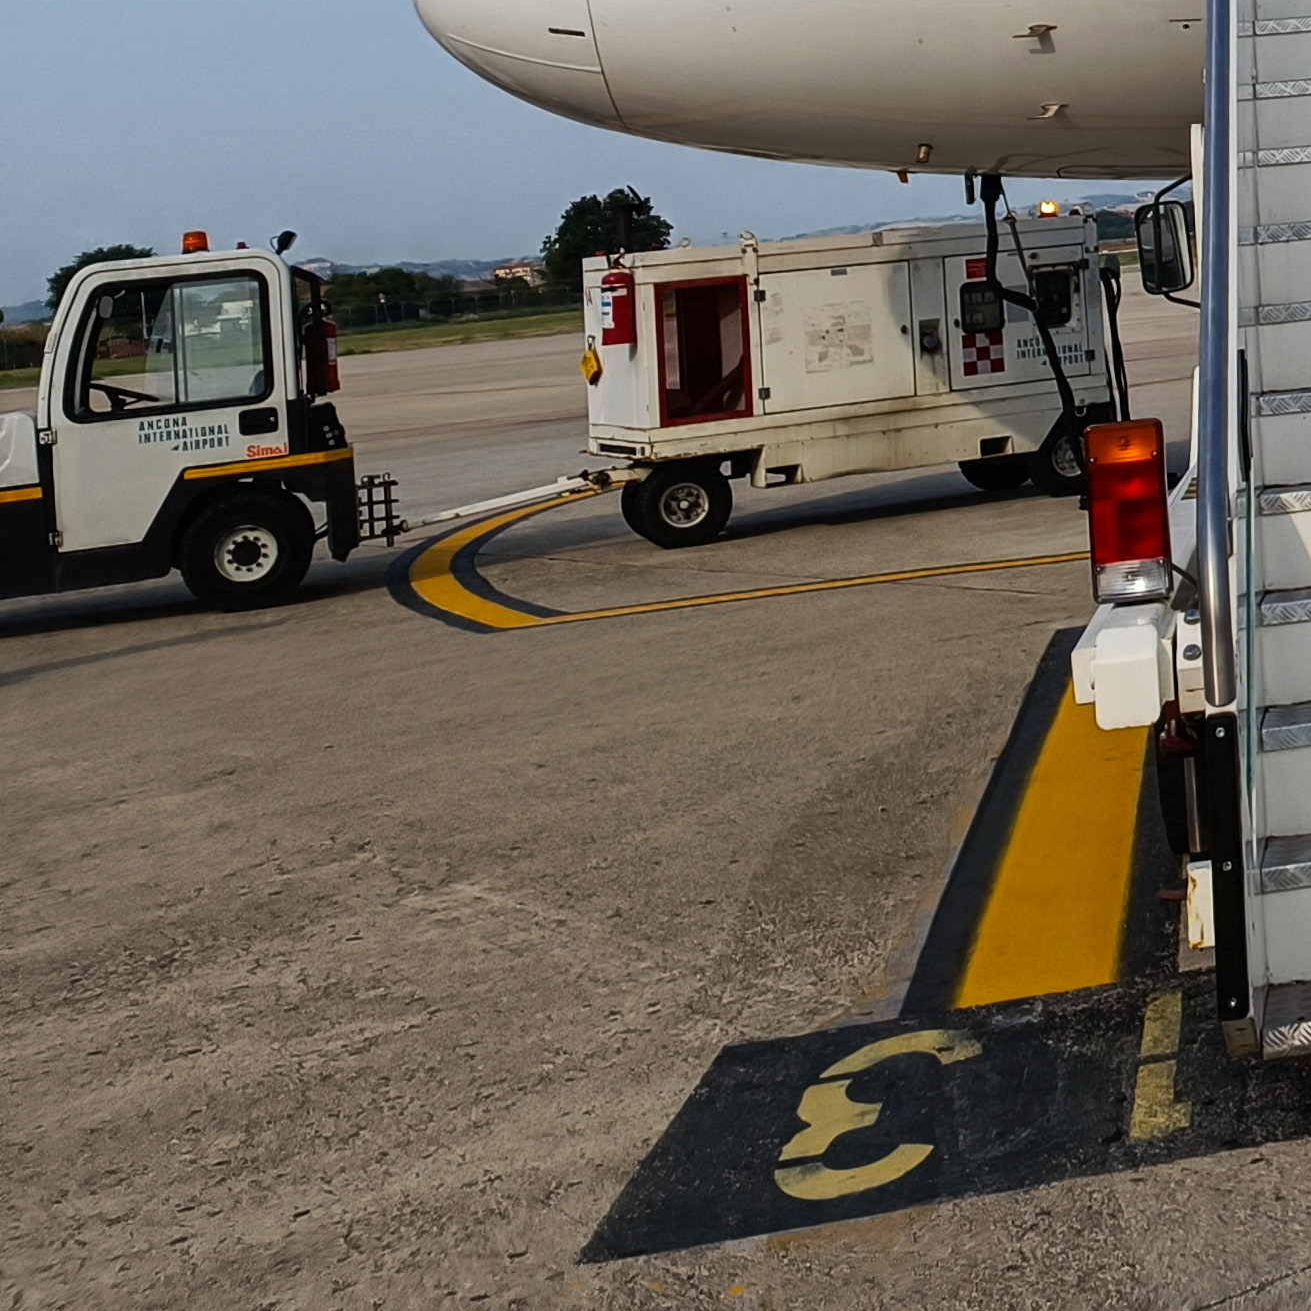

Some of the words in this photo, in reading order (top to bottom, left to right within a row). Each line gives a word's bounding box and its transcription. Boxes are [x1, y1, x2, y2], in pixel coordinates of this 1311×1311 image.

[138, 416, 187, 431] ANCONA
[138, 424, 230, 444] INTERNATIONAL
[182, 435, 230, 451] AIRPORT
